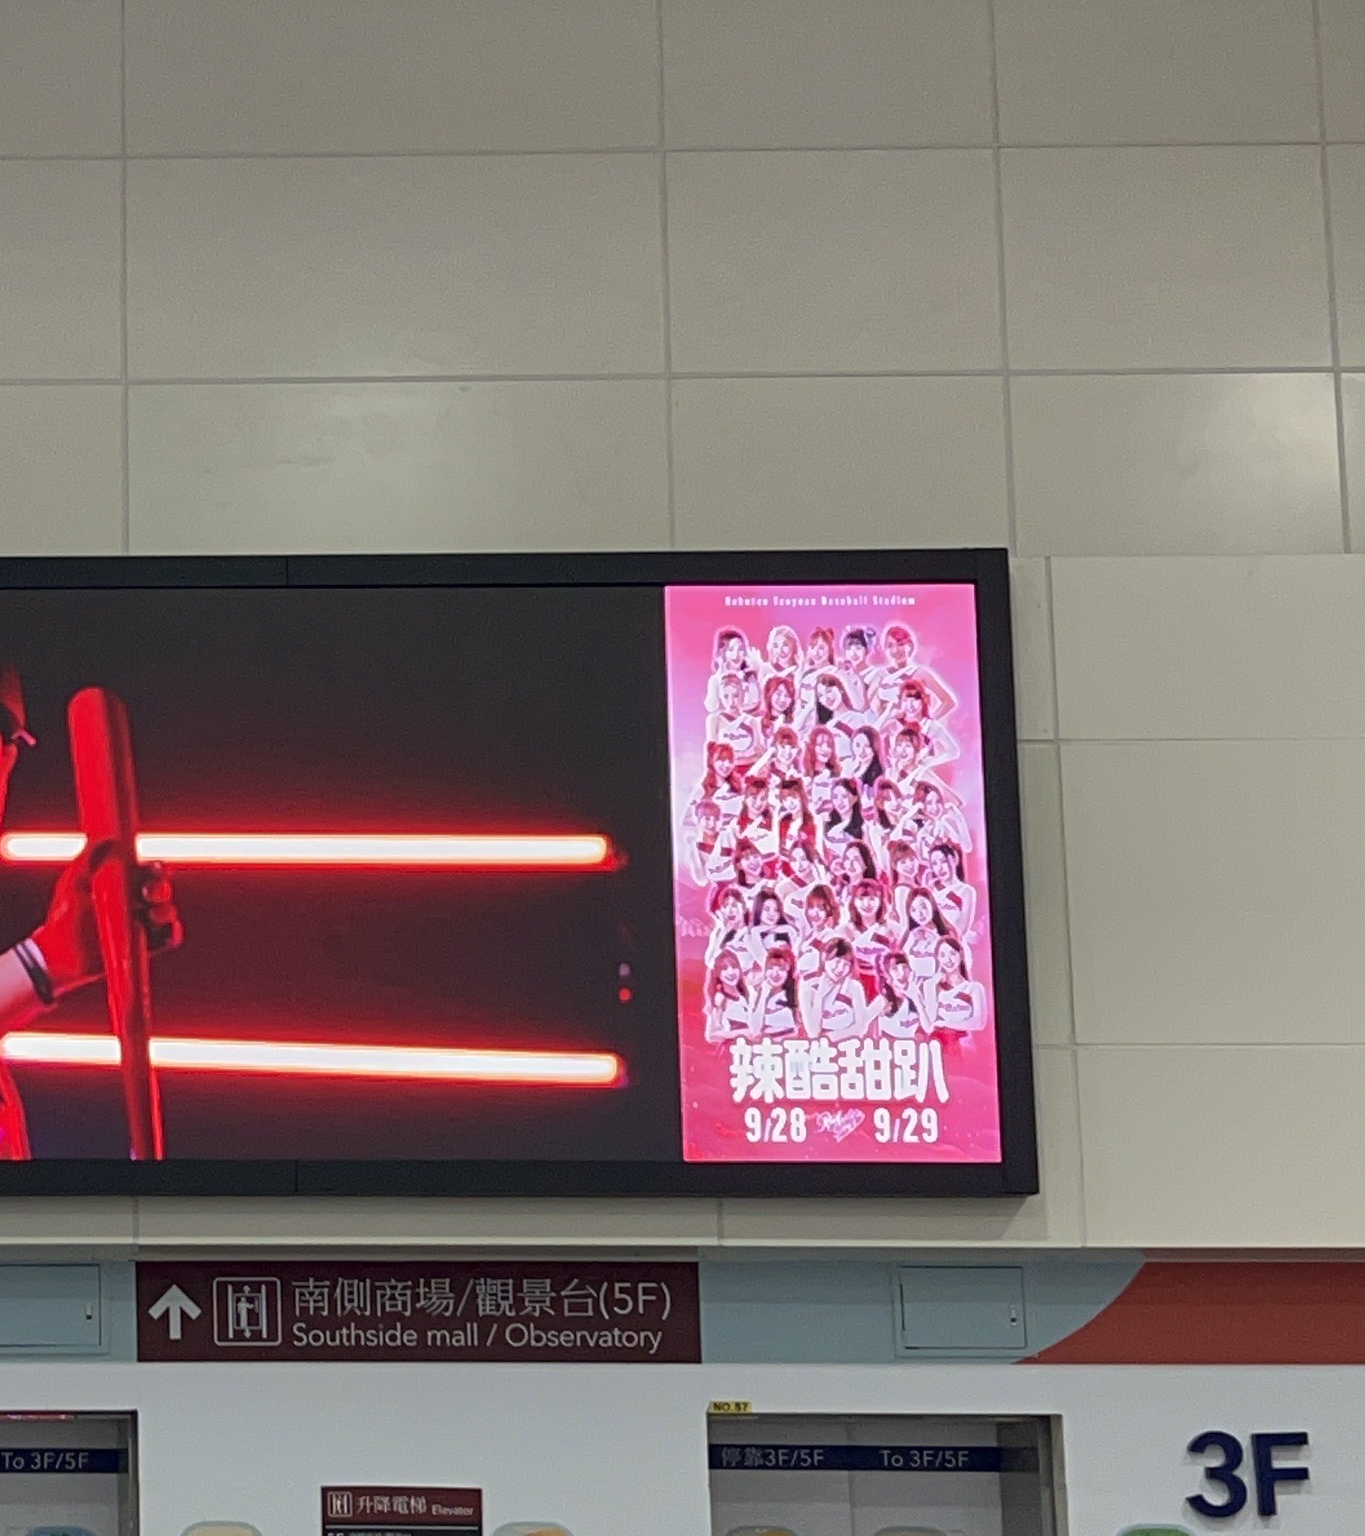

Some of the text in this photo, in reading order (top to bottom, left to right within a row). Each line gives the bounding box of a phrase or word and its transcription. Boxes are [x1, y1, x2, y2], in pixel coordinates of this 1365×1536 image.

[729, 1037, 950, 1103] 辣酷甜趴
[744, 1107, 807, 1143] 9/28
[873, 1107, 939, 1143] 9/29
[291, 1277, 671, 1320] 南側商場/觀景台(5F)
[292, 1322, 418, 1347] Southside
[427, 1322, 478, 1347] mall
[505, 1322, 663, 1355] Observatory
[1, 1452, 89, 1469] To 3F/5F
[878, 1450, 969, 1467] To 3F/5F
[1186, 1431, 1310, 1518] 3F
[356, 1495, 427, 1515] 升降電梯
